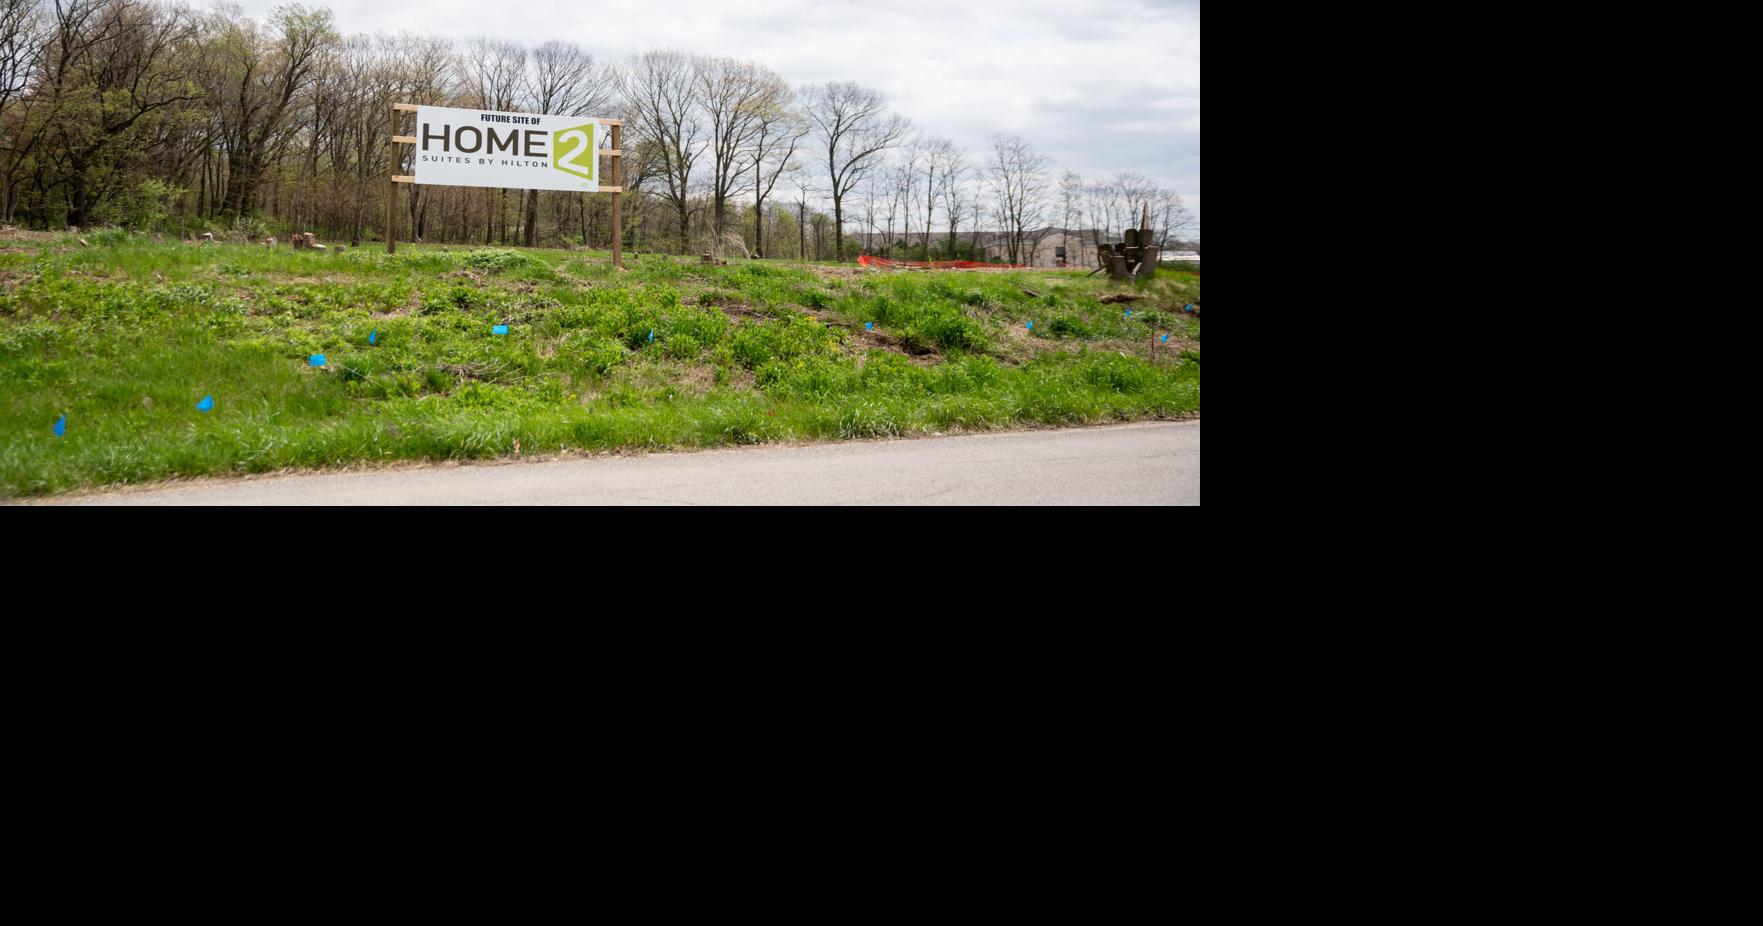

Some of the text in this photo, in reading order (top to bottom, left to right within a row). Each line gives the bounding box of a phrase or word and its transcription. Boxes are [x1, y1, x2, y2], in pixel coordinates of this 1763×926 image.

[480, 113, 541, 125] FUTURE SITE OF
[422, 123, 589, 175] HOME 2
[422, 155, 548, 168] SUITES BY HILTON
